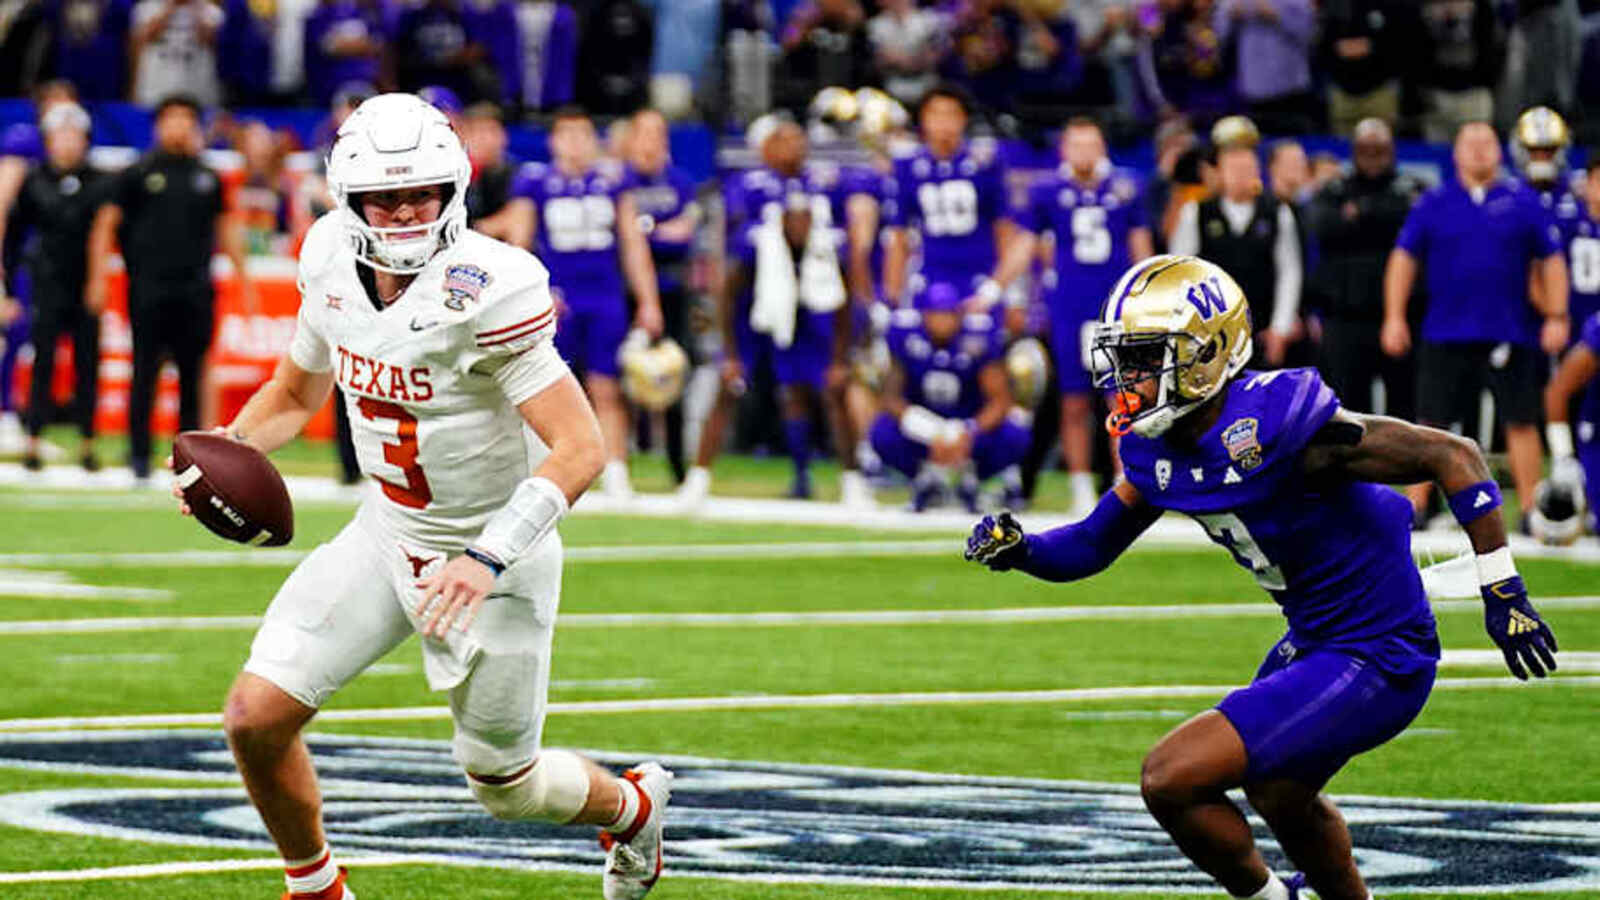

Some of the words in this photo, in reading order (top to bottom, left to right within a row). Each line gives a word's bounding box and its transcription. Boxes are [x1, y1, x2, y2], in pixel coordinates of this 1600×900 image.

[1072, 206, 1110, 264] 5
[1187, 276, 1228, 321] W
[337, 345, 434, 402] TEXAS
[357, 396, 434, 511] 3
